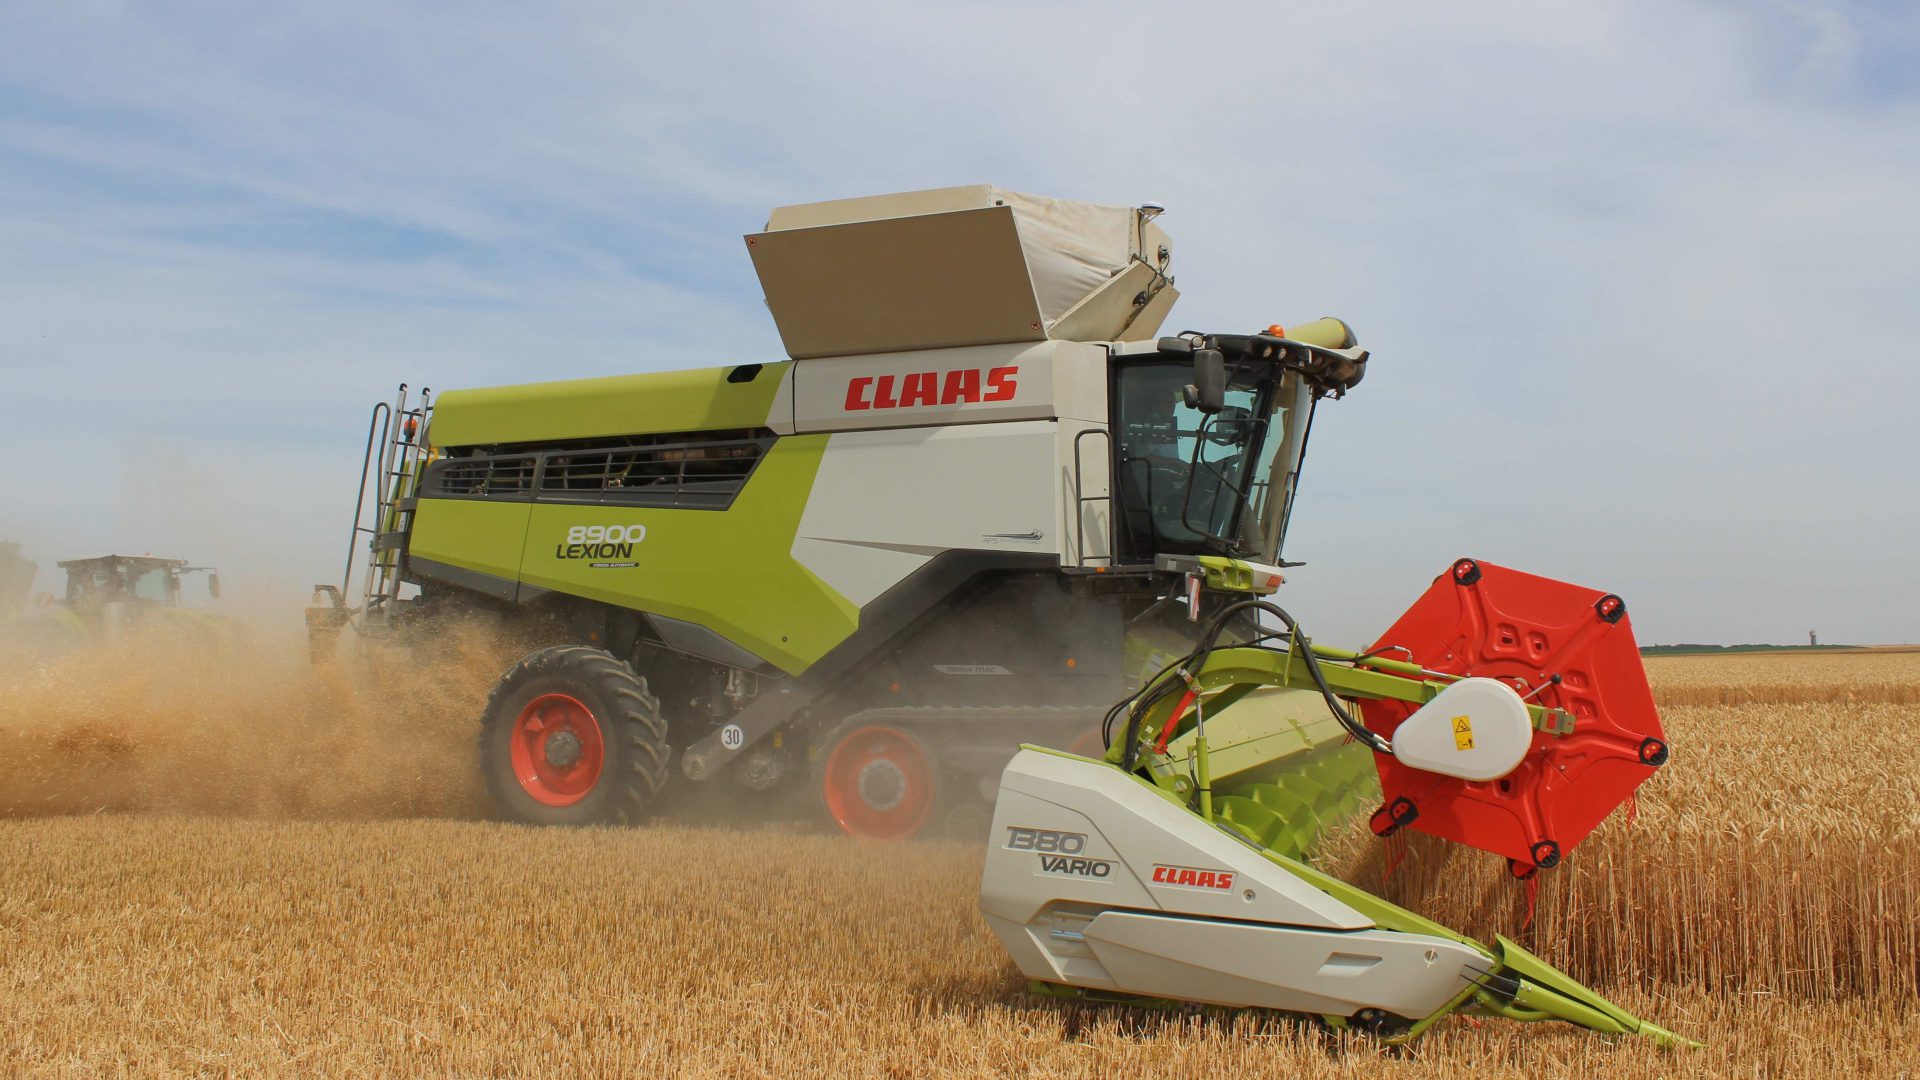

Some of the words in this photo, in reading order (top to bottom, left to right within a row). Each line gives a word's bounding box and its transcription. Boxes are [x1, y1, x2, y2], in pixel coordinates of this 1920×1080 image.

[844, 366, 1019, 411] CLAAS
[566, 524, 647, 545] 8900
[556, 543, 634, 560] LEXION
[724, 728, 740, 745] 30
[1006, 829, 1085, 854] 1380
[1040, 855, 1111, 877] VARIO
[1152, 866, 1233, 889] CLAAS
